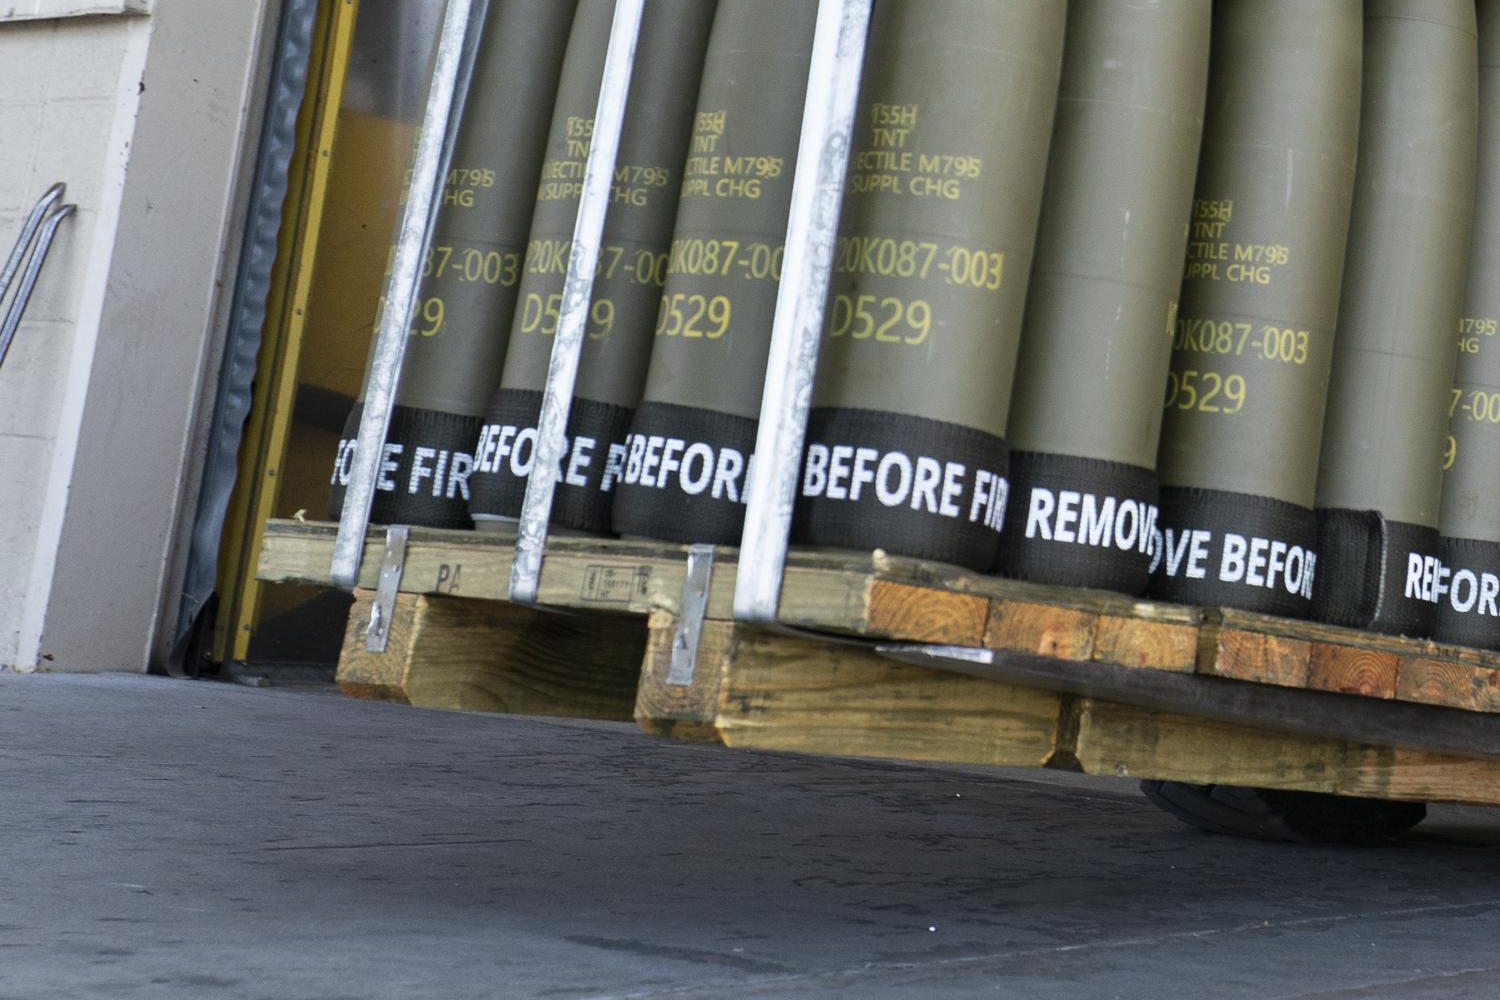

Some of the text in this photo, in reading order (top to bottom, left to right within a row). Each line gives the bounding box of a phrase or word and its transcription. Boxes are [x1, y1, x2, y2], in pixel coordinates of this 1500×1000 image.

[872, 128, 910, 147] TNT
[567, 140, 588, 158] TN
[724, 157, 784, 178] M795
[918, 154, 982, 178] M795
[546, 182, 583, 200] SUPP
[715, 178, 761, 198] CHG
[909, 176, 960, 200] CHG
[1234, 244, 1290, 265] M795
[1227, 264, 1271, 285] CHG
[829, 294, 932, 345] D529
[473, 424, 596, 487] BEFOE
[802, 443, 966, 518] BEFORE
